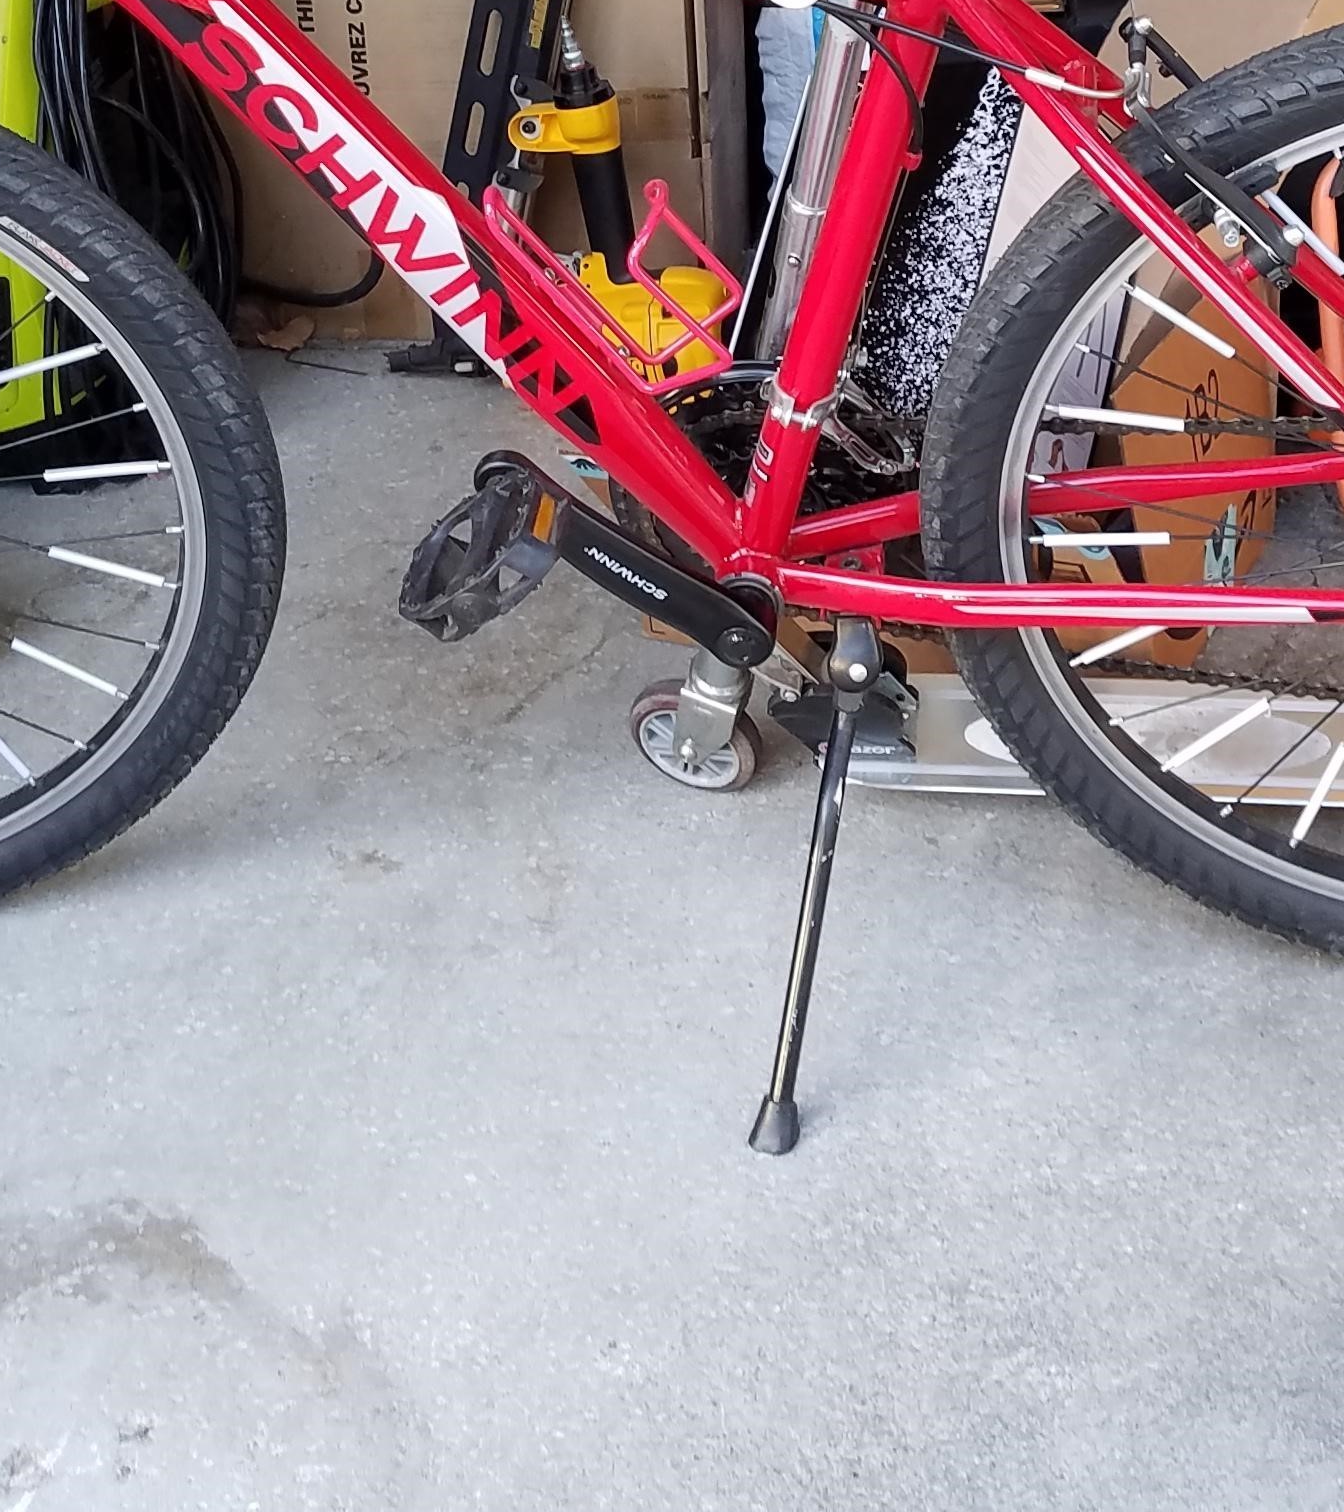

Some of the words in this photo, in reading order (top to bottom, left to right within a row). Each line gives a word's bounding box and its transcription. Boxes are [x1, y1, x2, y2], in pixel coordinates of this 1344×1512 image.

[348, 22, 371, 96] UVREZ
[183, 22, 590, 411] SCHWINN
[587, 546, 669, 601] SCHWINN
